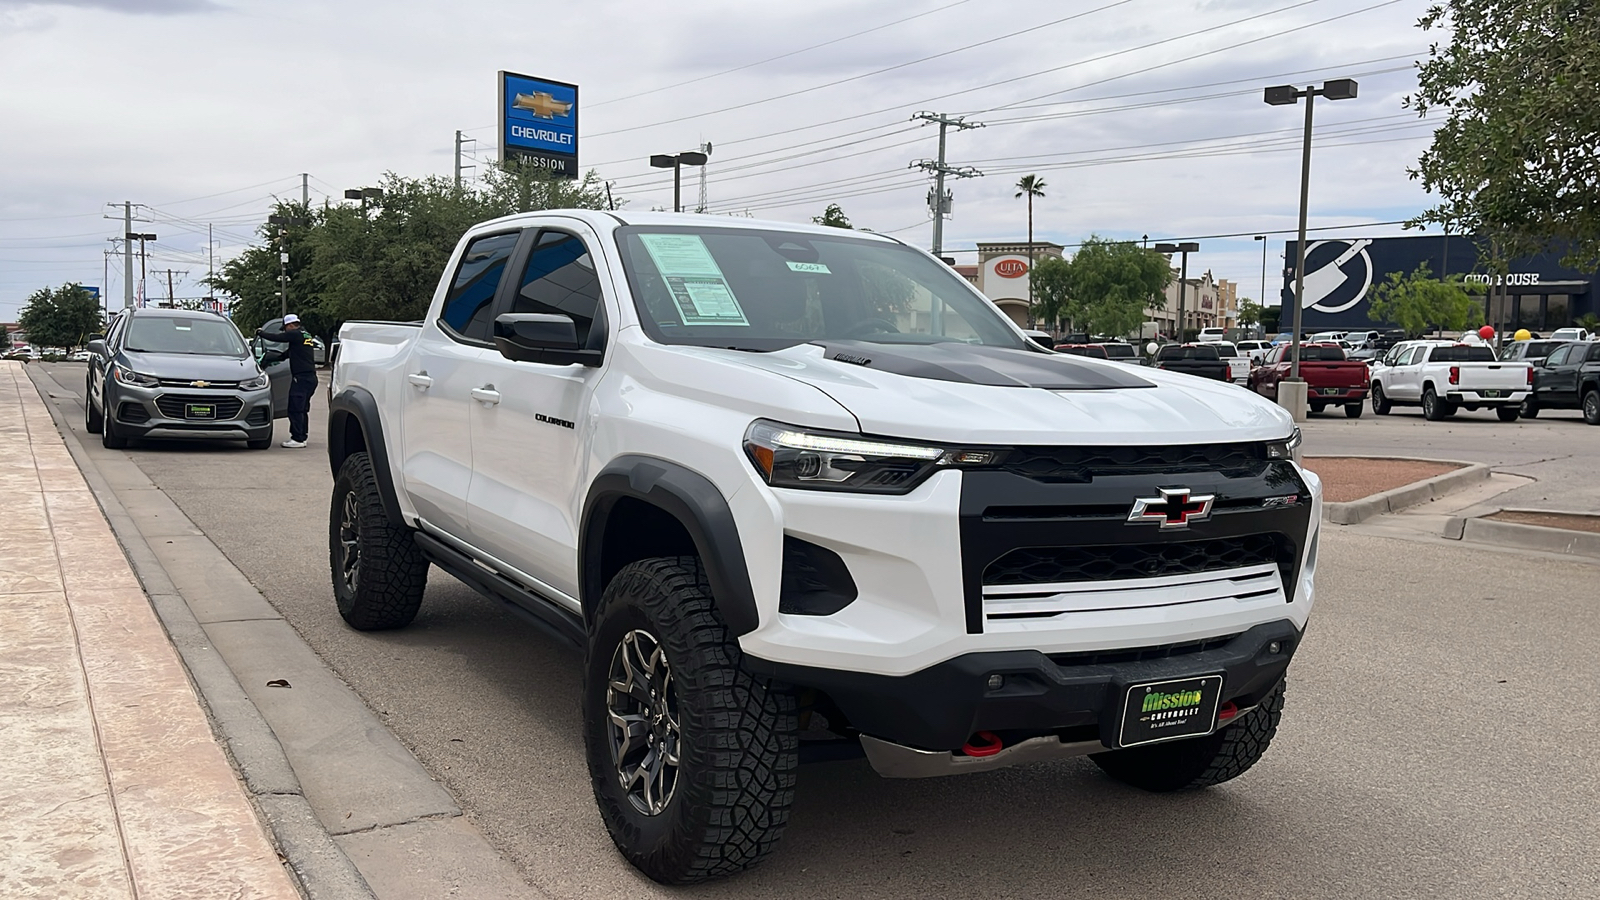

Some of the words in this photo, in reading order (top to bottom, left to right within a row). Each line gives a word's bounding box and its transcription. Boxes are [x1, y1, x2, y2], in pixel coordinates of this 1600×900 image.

[511, 125, 573, 145] CHEVROLET
[520, 155, 565, 171] MISSION
[535, 413, 575, 430] COLORADO
[1142, 689, 1202, 712] Mission
[1150, 707, 1199, 721] CHEVROLET
